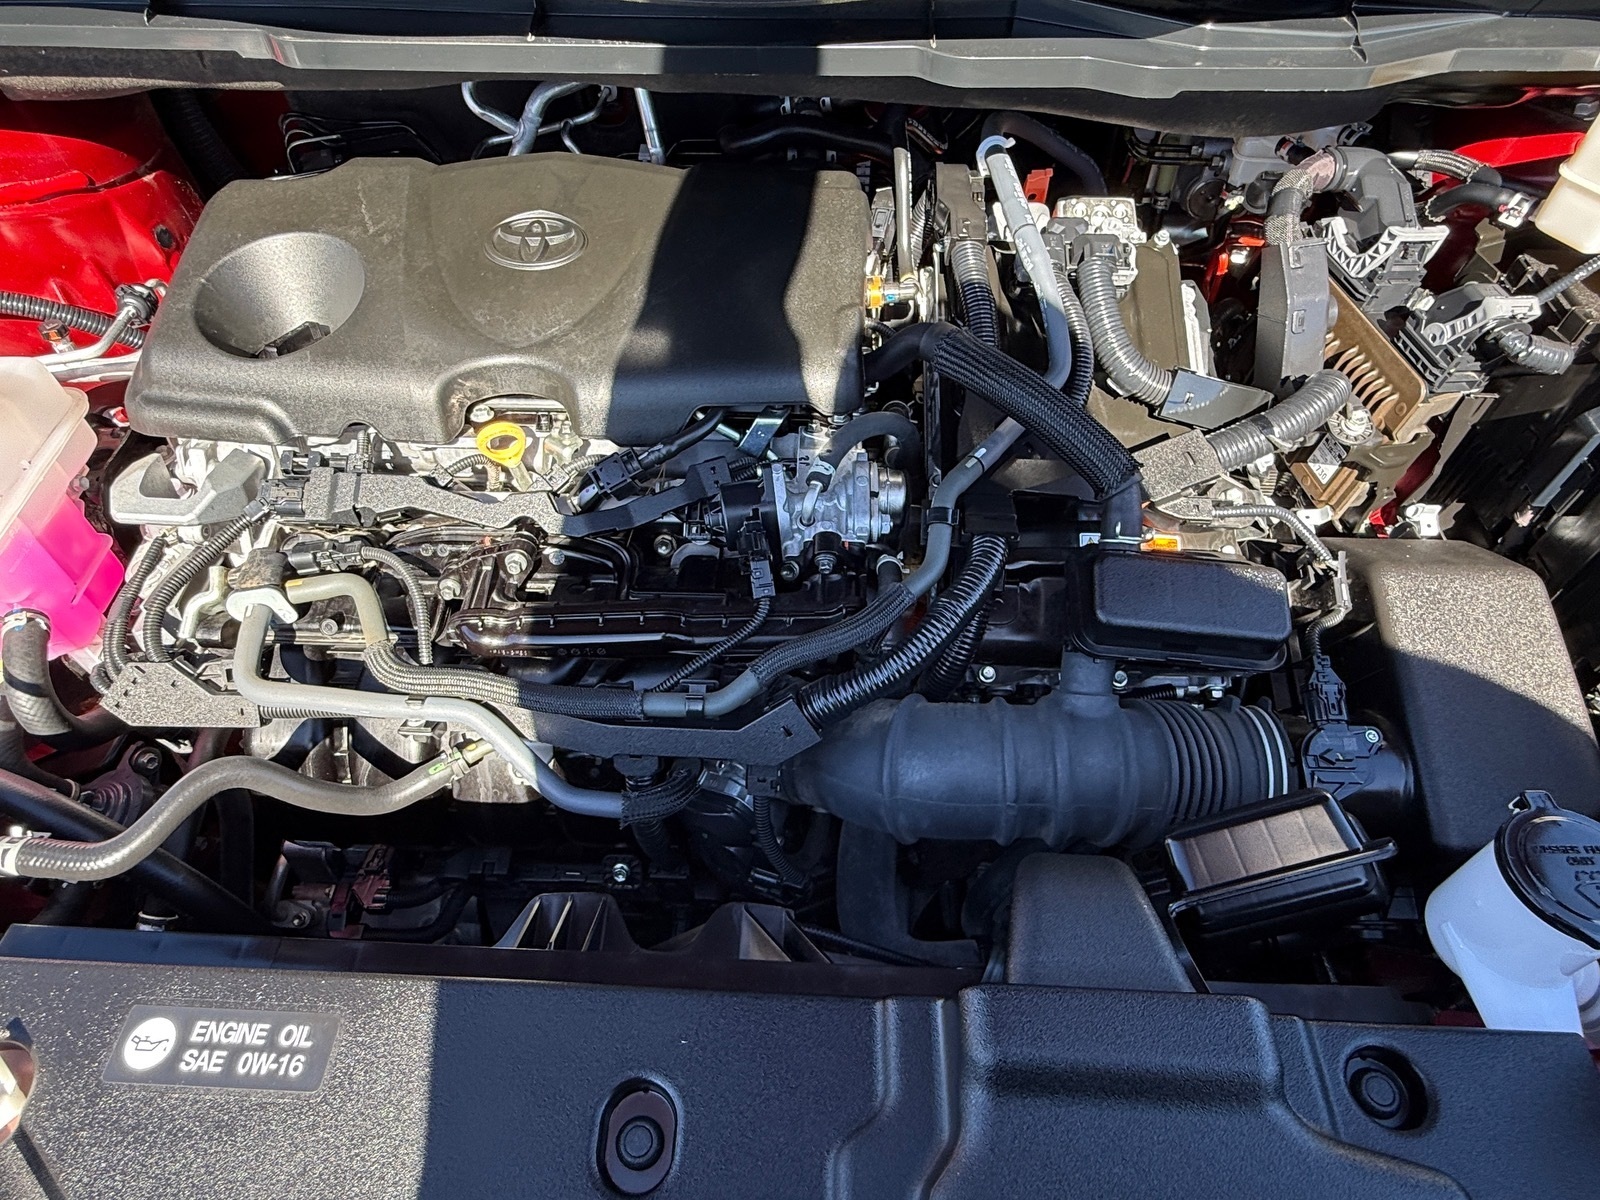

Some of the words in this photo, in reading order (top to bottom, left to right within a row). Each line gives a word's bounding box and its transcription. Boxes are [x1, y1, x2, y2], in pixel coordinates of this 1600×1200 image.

[189, 1020, 271, 1045] ENGINE
[279, 1025, 313, 1048] OIL
[179, 1049, 227, 1072] SAE
[237, 1052, 306, 1078] 0W-16
